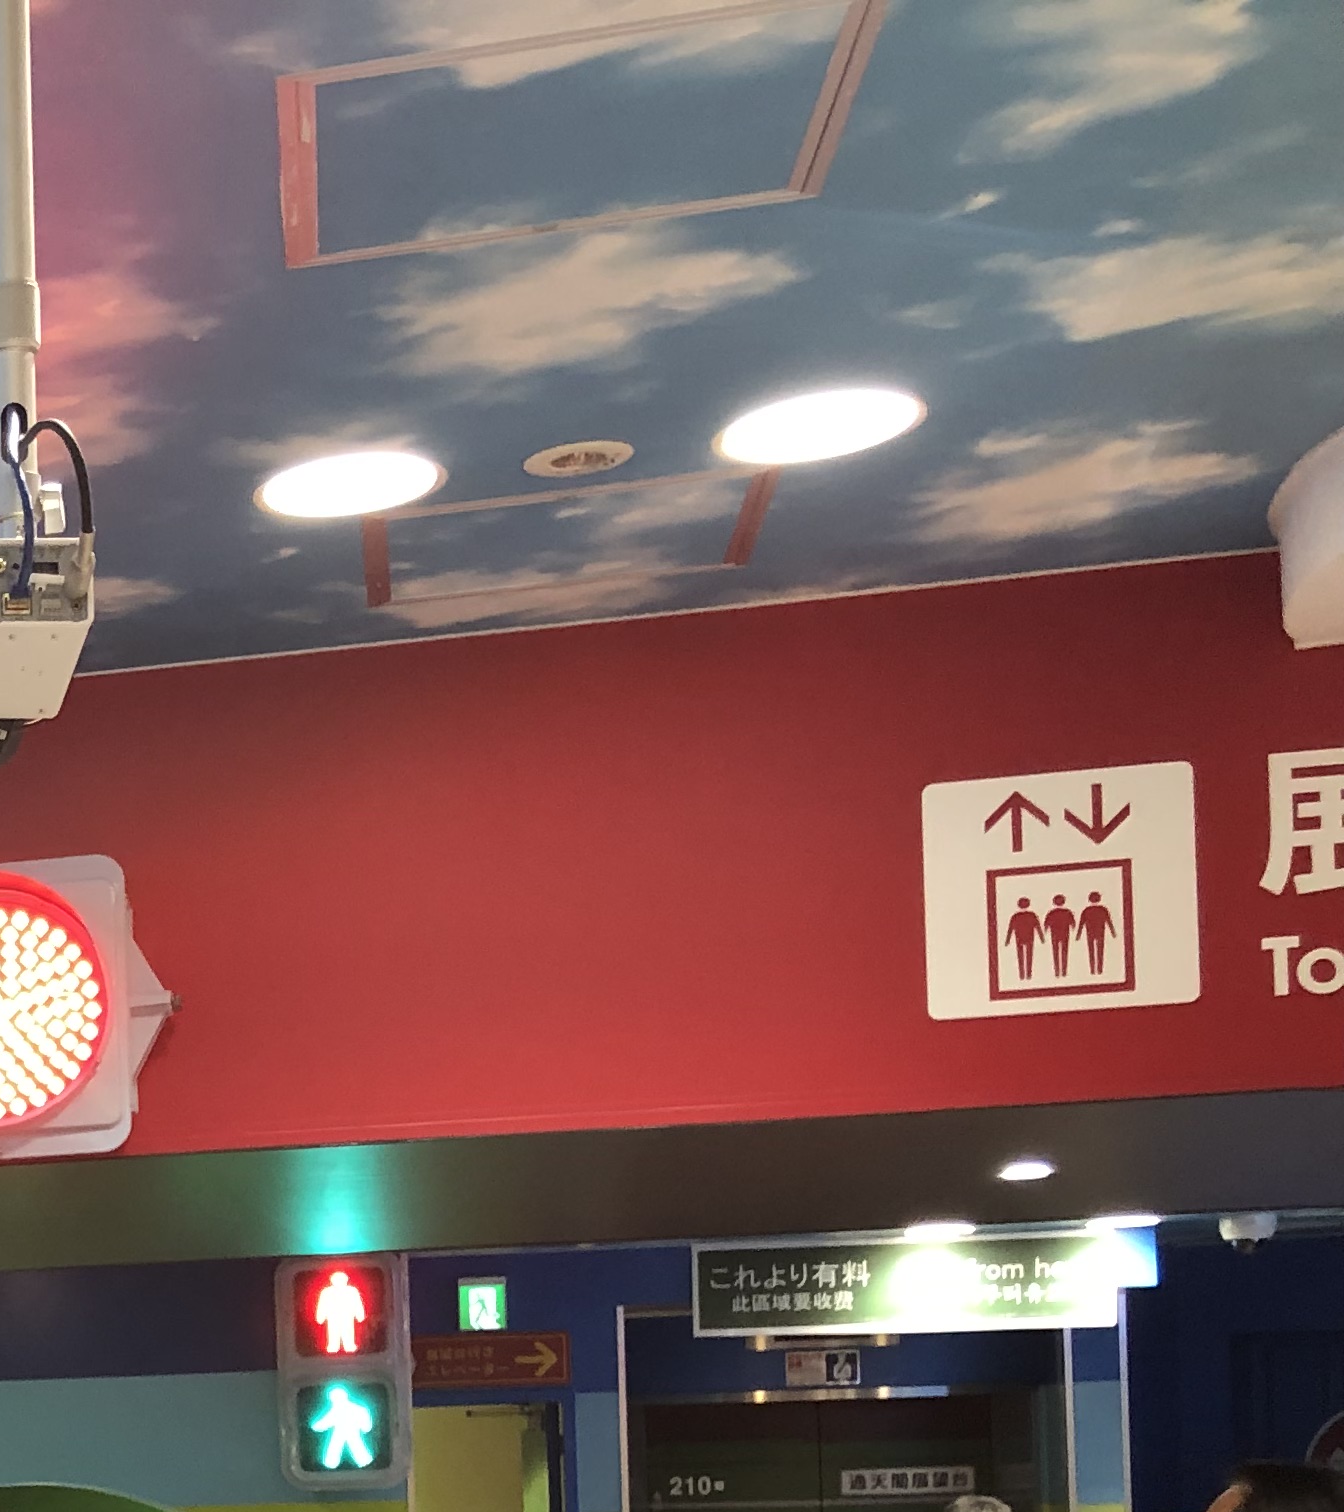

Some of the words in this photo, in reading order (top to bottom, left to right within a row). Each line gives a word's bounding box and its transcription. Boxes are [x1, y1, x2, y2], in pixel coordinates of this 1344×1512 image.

[710, 1259, 872, 1290] これより有料
